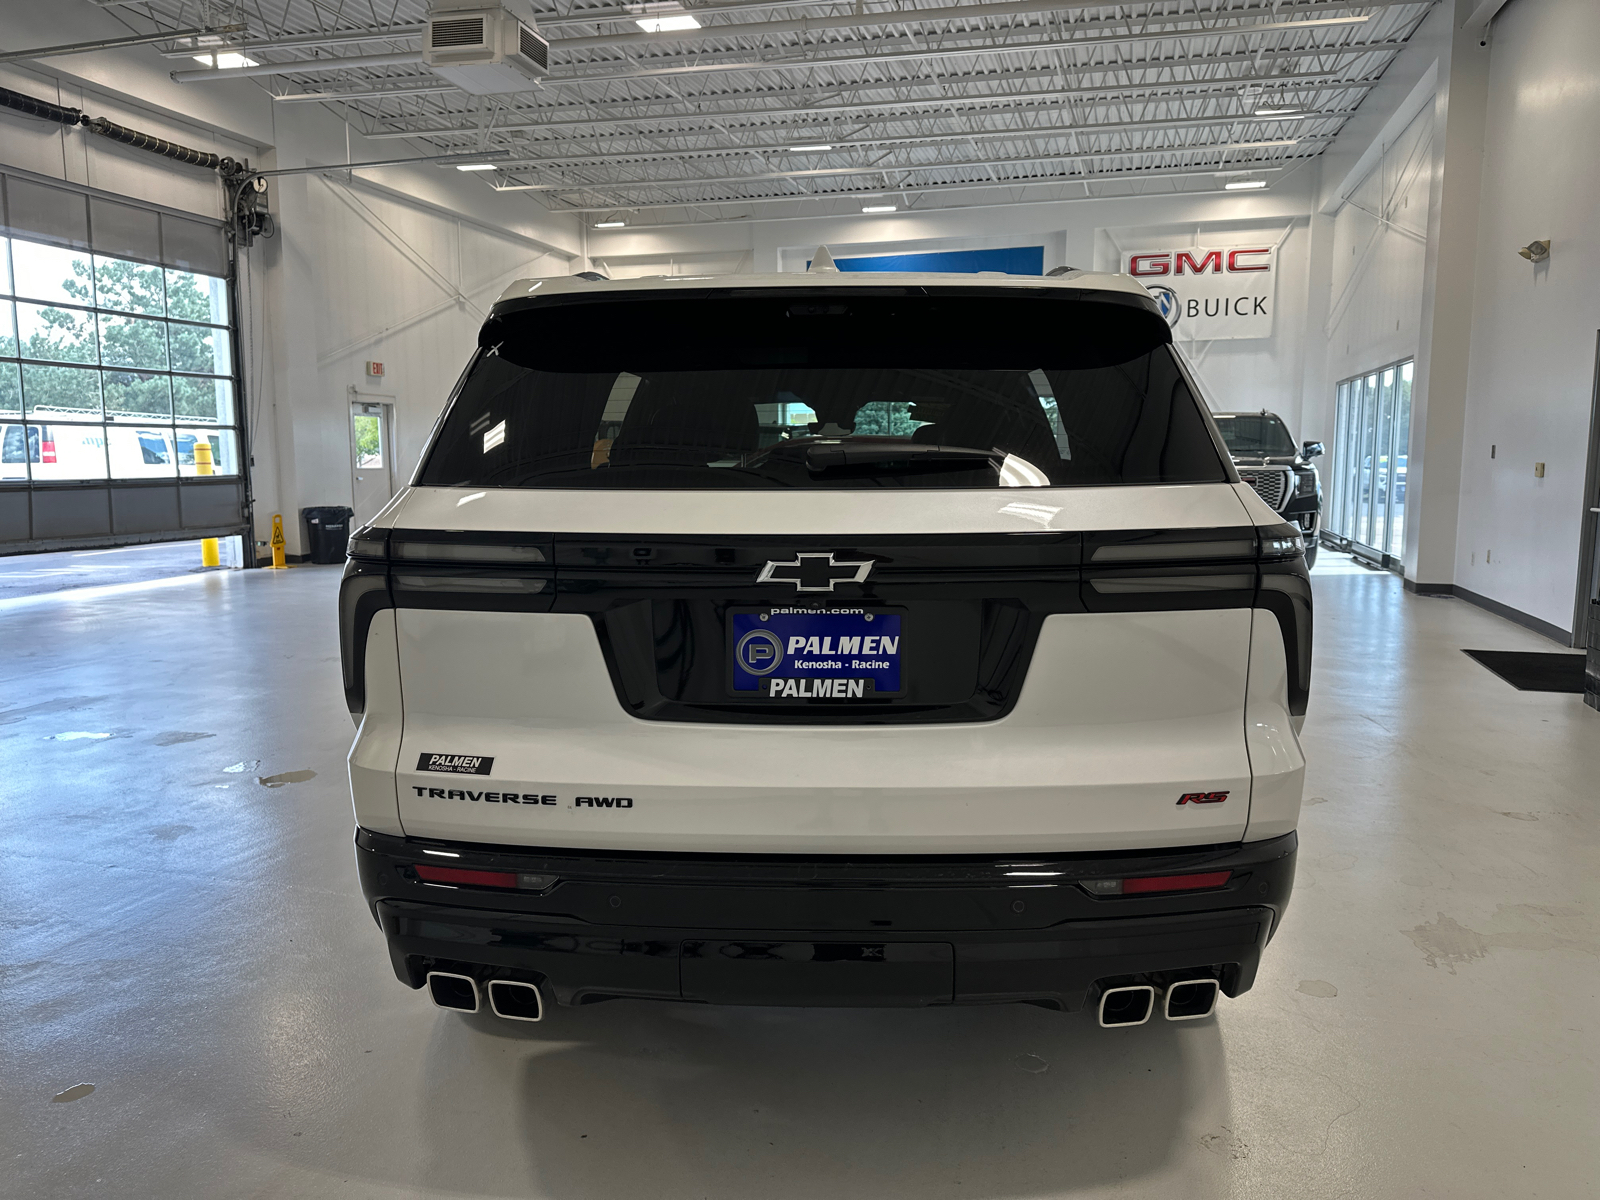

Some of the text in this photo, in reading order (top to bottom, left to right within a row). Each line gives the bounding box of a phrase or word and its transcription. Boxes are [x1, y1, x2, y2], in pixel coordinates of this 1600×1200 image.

[1129, 247, 1271, 278] GMC
[1187, 296, 1267, 318] BUICK
[372, 362, 383, 375] EXIT
[770, 606, 864, 616] palmen.com
[786, 635, 900, 655] PALMEN
[794, 659, 842, 669] Kenosha
[851, 659, 890, 669] Racine
[769, 678, 865, 698] PALMEN
[428, 764, 453, 772] KENOSHA
[429, 754, 482, 768] PALMEN
[412, 786, 633, 809] TRAVERSE AWD
[1175, 790, 1231, 806] RS
